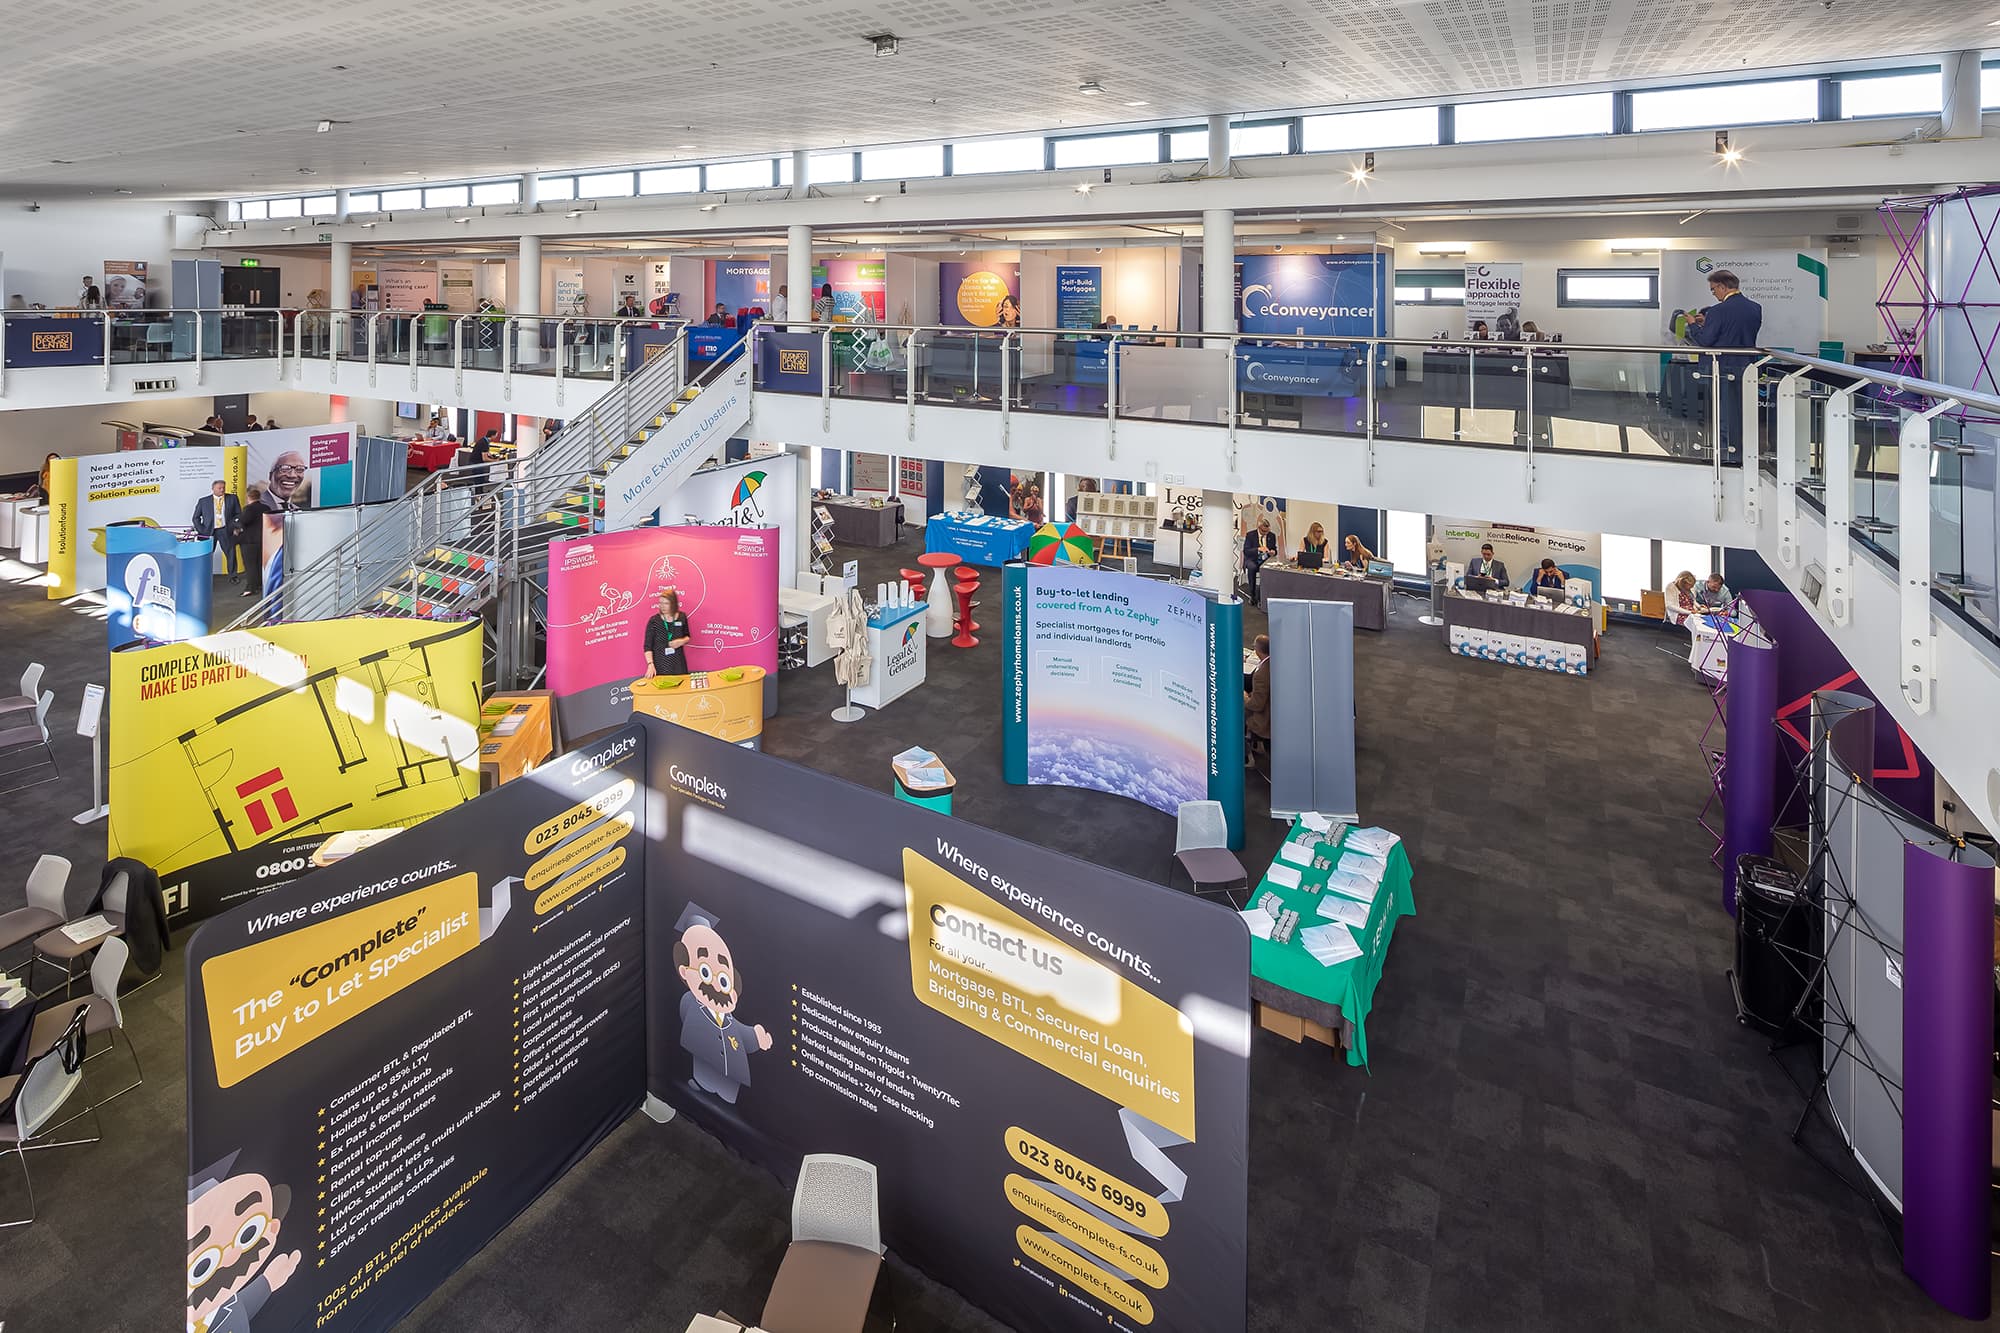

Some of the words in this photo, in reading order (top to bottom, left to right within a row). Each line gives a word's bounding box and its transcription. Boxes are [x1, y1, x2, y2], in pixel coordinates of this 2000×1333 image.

[1467, 291, 1508, 299] approach
[1468, 279, 1520, 290] Flexible
[1260, 303, 1374, 320] eConveyancer
[784, 362, 807, 371] CENTRE
[312, 451, 334, 459] guidance
[623, 478, 652, 503] More
[652, 432, 700, 476] Exhibitors
[700, 396, 737, 435] Upstairs
[89, 473, 110, 482] your
[113, 469, 153, 479] specialist
[90, 464, 113, 472] Need
[124, 460, 149, 468] home
[89, 491, 125, 500] Solution
[128, 487, 159, 495] Found.
[90, 479, 128, 490] mortgage
[131, 476, 165, 485] cases?
[1165, 488, 1203, 511] Lega
[1446, 530, 1480, 539] InterBay
[1487, 531, 1540, 544] KentReliance
[1548, 539, 1585, 552] Prestige
[564, 553, 595, 565] IPSWICH
[153, 586, 169, 595] FLEET
[1036, 587, 1089, 601] Buy-to-let
[1092, 590, 1129, 606] lending
[1036, 601, 1076, 611] covered
[1078, 602, 1102, 614] from
[1104, 605, 1112, 614] A
[1115, 606, 1125, 616] to
[1127, 608, 1160, 626] Zephyr
[1167, 604, 1202, 625] ZEPHYR
[586, 622, 606, 633] Unusual
[606, 620, 628, 628] business
[1036, 621, 1075, 630] Specialist
[1077, 623, 1121, 636] mortgages
[1121, 628, 1133, 637] for
[1134, 631, 1166, 647] portfolio
[1036, 632, 1051, 640] and
[1053, 632, 1093, 643] individual
[1095, 635, 1132, 649] landlords
[887, 648, 906, 666] Legal
[907, 645, 913, 653] &
[889, 653, 917, 676] General
[1013, 586, 1022, 723] www.zephyrhomeloans.co.uk
[141, 655, 199, 683] COMPLEX
[1046, 663, 1079, 672] underwriting
[1050, 670, 1075, 678] decisions
[1112, 670, 1142, 682] applications
[1115, 663, 1138, 673] Complex
[141, 678, 177, 701] MAKE
[182, 674, 198, 691] US
[202, 668, 232, 687] PART
[1113, 678, 1141, 689] considered
[1209, 623, 1218, 775] www.zephyrhomeloans.co.uk
[669, 764, 727, 799] Complete
[536, 824, 559, 844] 023
[562, 806, 593, 831] 8045
[595, 788, 624, 813] 6999
[283, 846, 295, 854] FOR
[530, 821, 630, 881] enquiries@complete-fs.co.uk
[256, 858, 304, 878] 0800
[540, 855, 620, 908] www.complete-fs.co.uk
[247, 906, 306, 936] Where
[310, 875, 398, 916] experience
[401, 859, 457, 886] counts...
[937, 837, 989, 882] Where
[990, 874, 1084, 938] experience
[1087, 931, 1162, 984] counts...
[929, 904, 1027, 962] Contact
[1032, 948, 1064, 976] us
[522, 962, 542, 980] Light
[543, 930, 593, 965] refurbishment
[929, 938, 946, 953] For
[948, 946, 960, 960] all
[962, 953, 993, 974] your...
[233, 1016, 288, 1059] Buy
[293, 999, 320, 1024] to
[327, 971, 364, 1006] Let
[368, 910, 470, 980] Specialist
[232, 988, 284, 1026] The
[802, 988, 842, 1014] Established
[843, 1009, 862, 1025] since
[863, 1019, 882, 1034] 1993
[929, 980, 988, 1019] Bridging
[992, 1008, 1002, 1023] &
[1004, 1013, 1098, 1066] Commercial
[1102, 1058, 1180, 1104] enquiries
[1036, 1007, 1100, 1046] Secured
[1104, 1036, 1148, 1068] Loan,
[523, 1063, 554, 1091] Portfolio
[555, 1036, 589, 1066] Landlords
[801, 1064, 814, 1077] Top
[815, 1071, 858, 1101] commission
[859, 1097, 878, 1112] rates
[330, 1148, 363, 1175] Rental
[365, 1120, 401, 1150] income
[403, 1094, 437, 1122] busters
[1019, 1140, 1050, 1167] 023
[1054, 1158, 1097, 1192] 8045
[1101, 1185, 1146, 1218] 6999
[1012, 1187, 1159, 1276] enquiries@complete-fs.co.uk
[1023, 1236, 1144, 1313] www.complete-fs.co.uk
